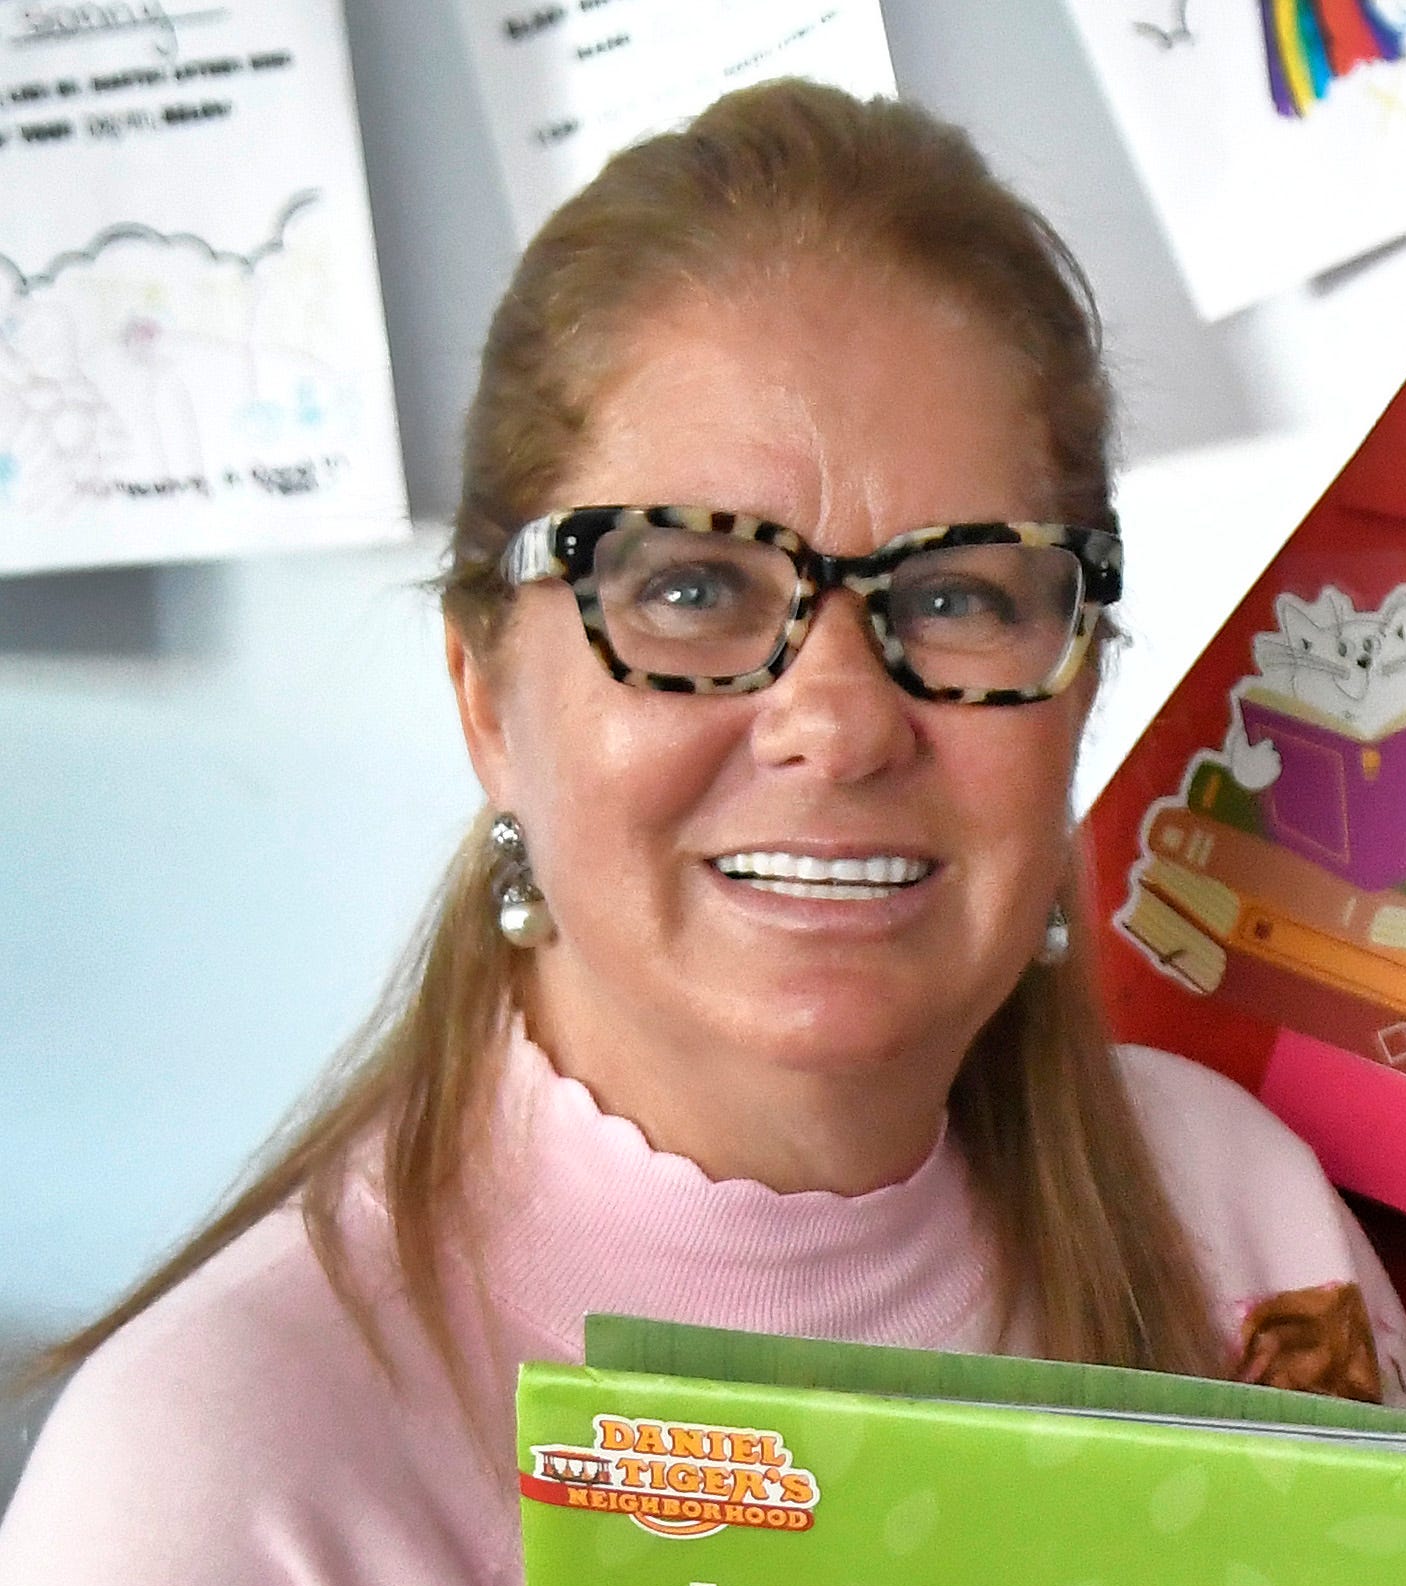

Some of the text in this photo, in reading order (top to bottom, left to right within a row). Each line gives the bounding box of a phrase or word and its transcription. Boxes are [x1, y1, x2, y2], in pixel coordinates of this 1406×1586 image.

[599, 1418, 785, 1468] DANIEL
[615, 1456, 814, 1504] TIGER'S
[567, 1486, 809, 1531] NEIGHBORHOOD
